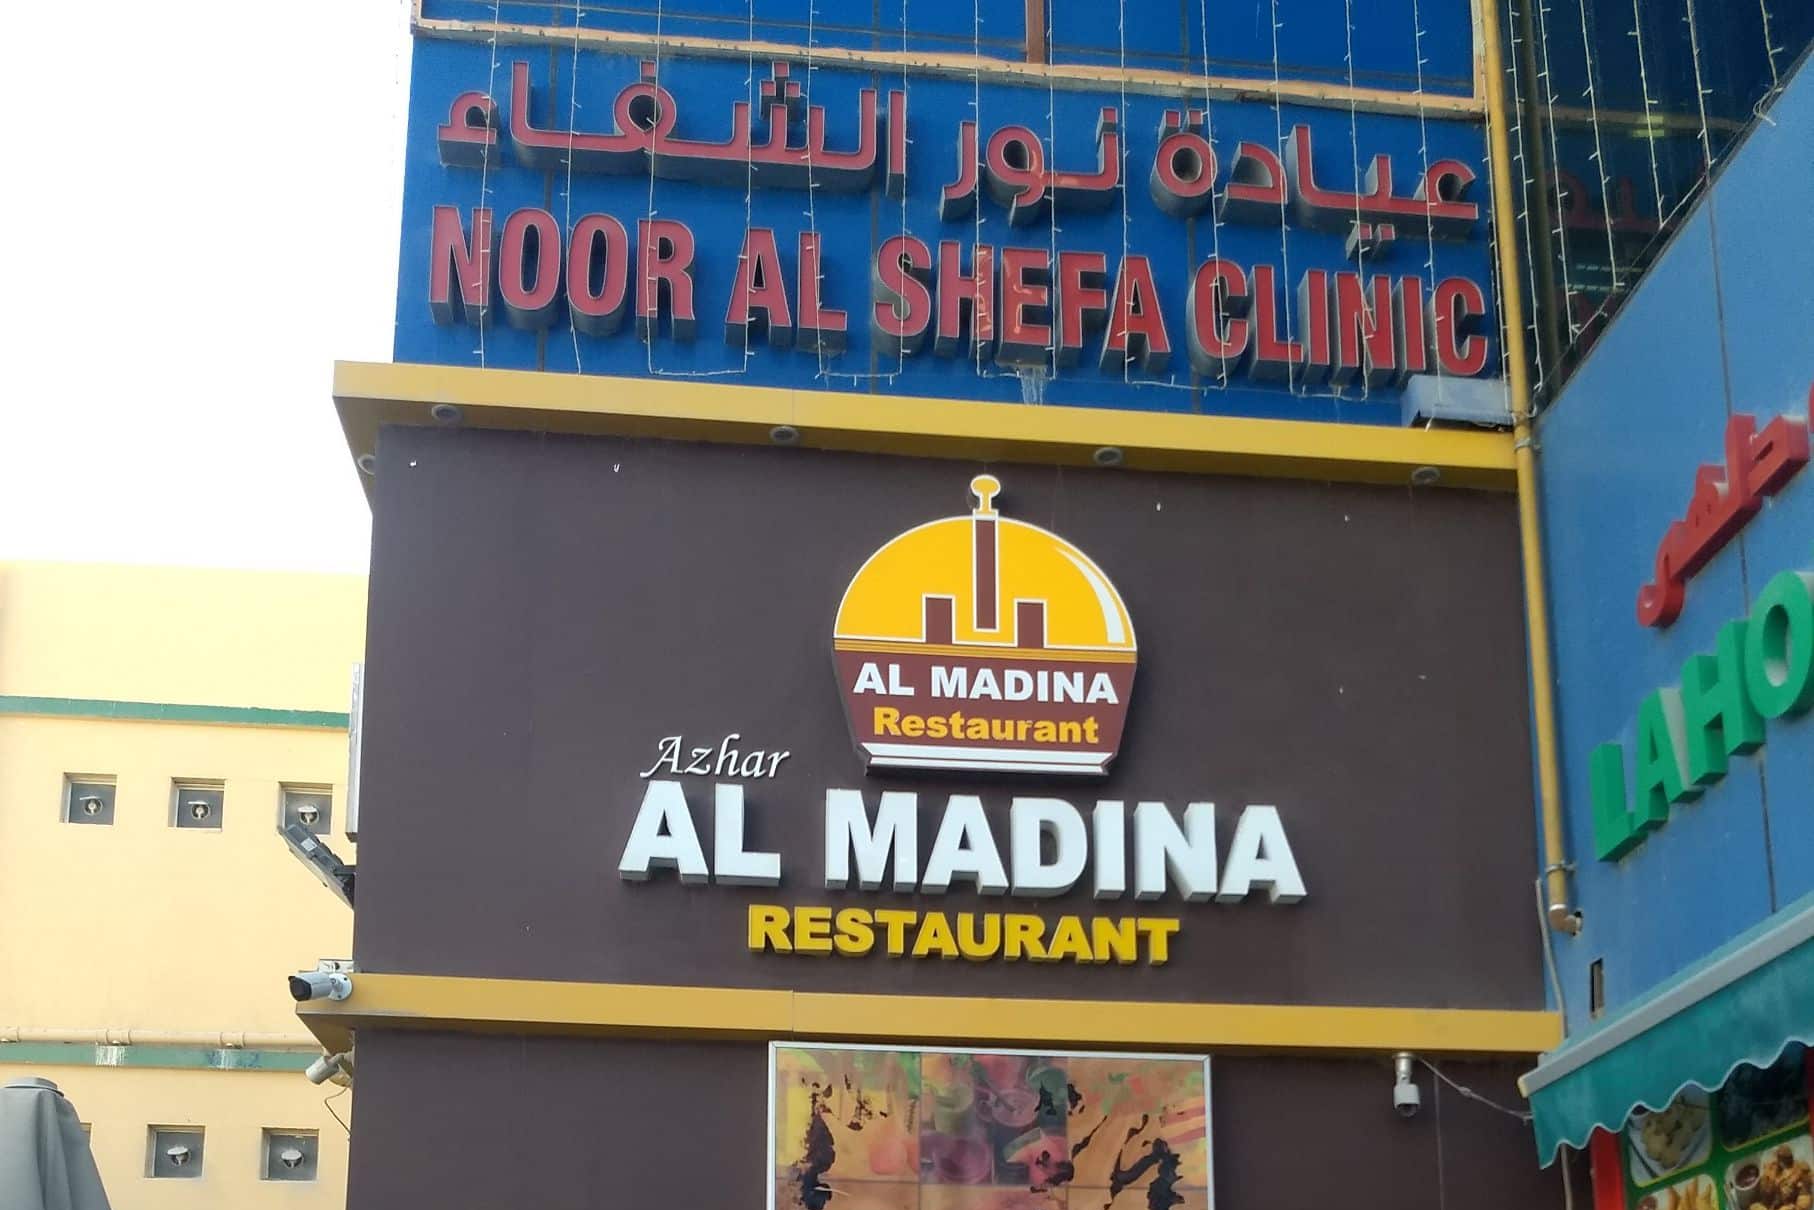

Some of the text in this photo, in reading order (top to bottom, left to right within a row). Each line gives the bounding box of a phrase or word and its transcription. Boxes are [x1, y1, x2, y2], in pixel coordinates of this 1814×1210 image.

[438, 60, 906, 182] الشفاء
[942, 107, 1119, 216] نور
[1152, 108, 1479, 250] عيادة
[430, 205, 1488, 380] NOOR AL SHEFA CLINIC
[1637, 381, 1814, 629] طعم
[853, 661, 1119, 704] AL MADINA
[873, 706, 1099, 744] Restaurant
[1589, 560, 1814, 862] LAHO
[639, 733, 791, 780] Azhar
[619, 780, 1307, 905] AL MADINA
[748, 904, 1180, 965] RESTAURANT
